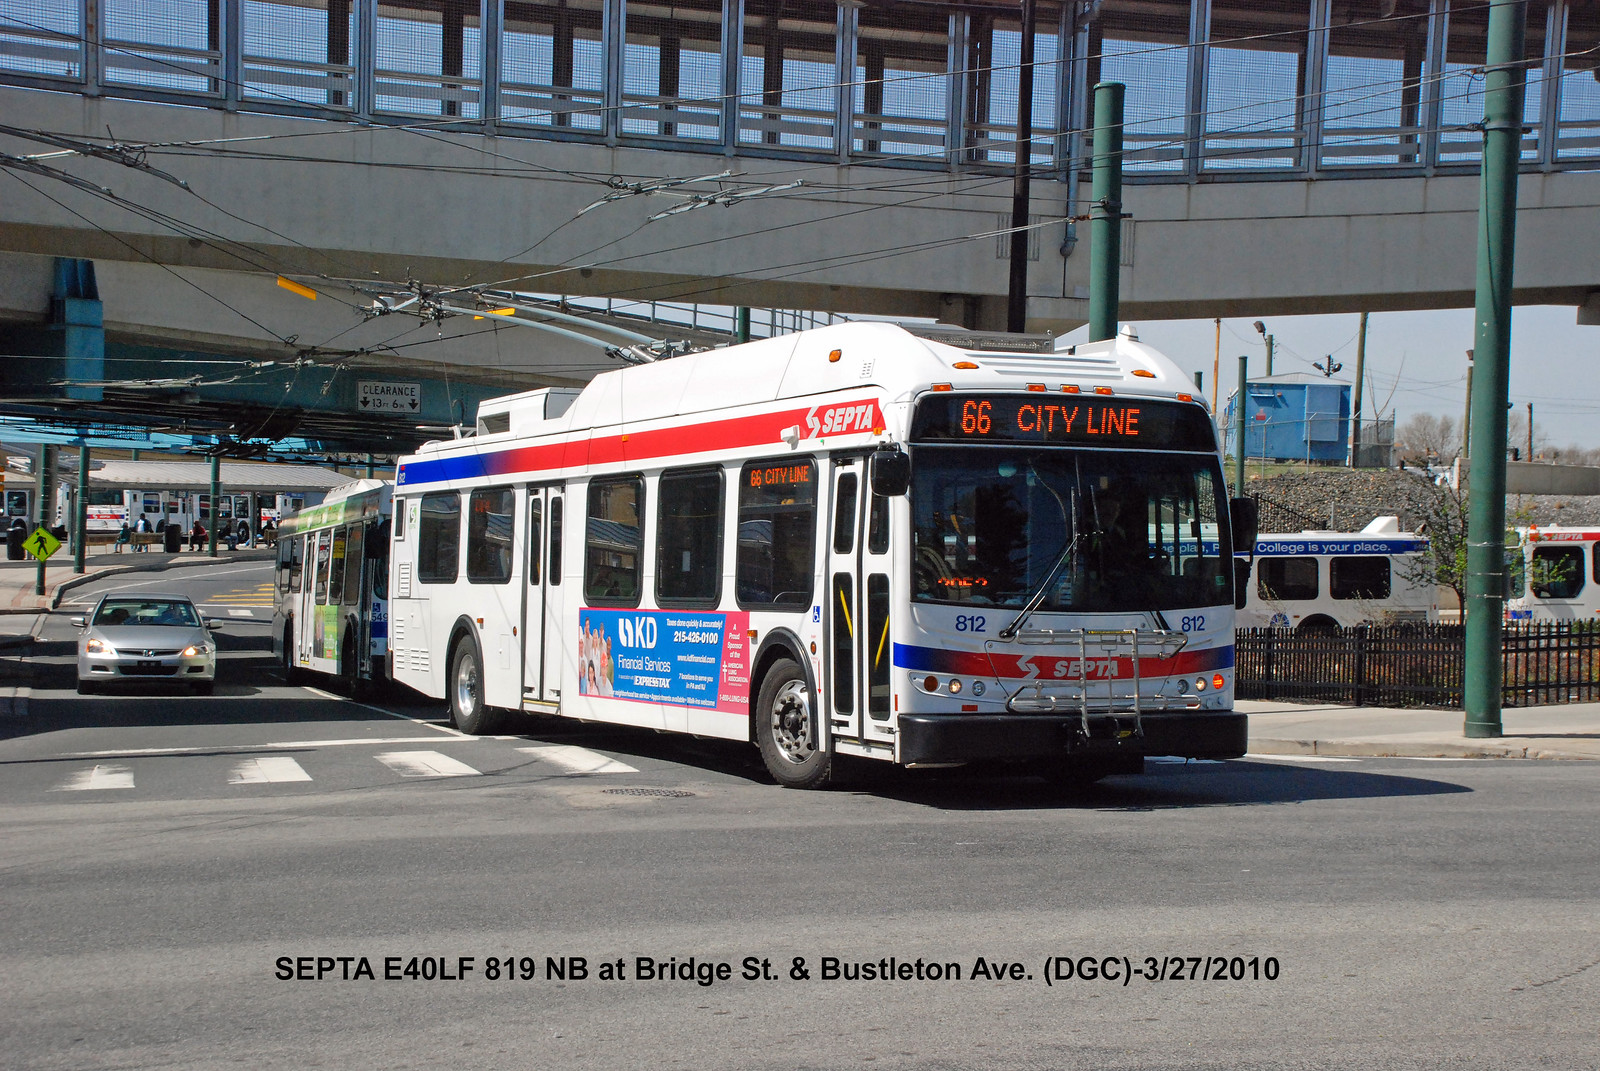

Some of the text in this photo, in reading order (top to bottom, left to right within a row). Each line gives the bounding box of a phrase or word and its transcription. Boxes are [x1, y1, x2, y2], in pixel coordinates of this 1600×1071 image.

[363, 384, 416, 397] CLEARANCE
[372, 398, 382, 408] 13
[392, 399, 399, 409] 6
[822, 404, 874, 434] SEPTA
[962, 400, 1140, 435] 66 CITY LINE
[750, 465, 809, 487] 66 CITY LINE
[1551, 533, 1583, 541] SEPTA
[1258, 542, 1391, 554] College is your place.
[677, 619, 686, 627] done
[686, 619, 699, 629] quickly
[955, 615, 986, 632] 812
[1181, 615, 1205, 632] 812
[635, 616, 657, 649] KD
[673, 631, 719, 645] 215-426-0100
[728, 632, 740, 640] Proud
[727, 641, 743, 650] Sponsor
[618, 654, 671, 673] Financial Services
[1053, 659, 1119, 678] SEPTA
